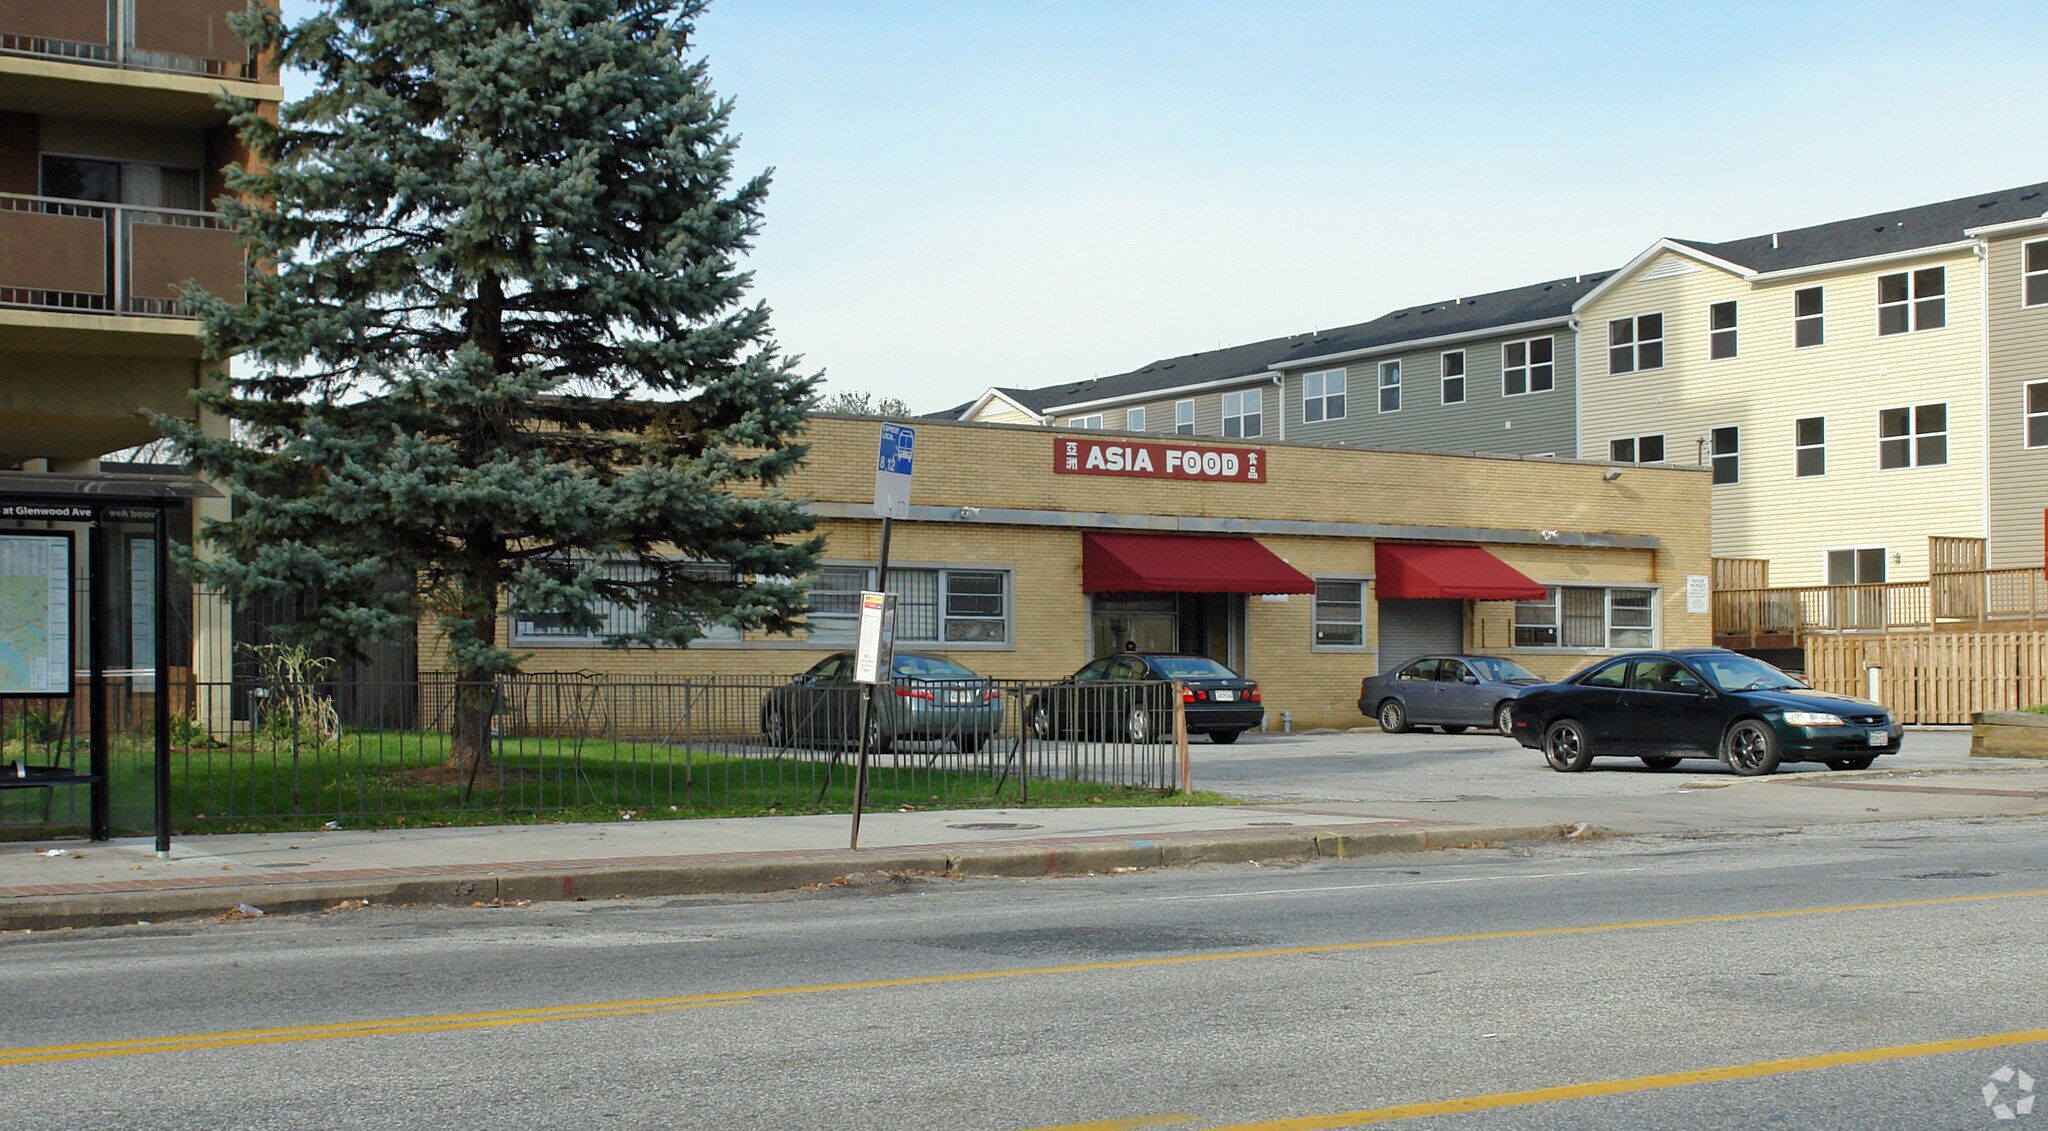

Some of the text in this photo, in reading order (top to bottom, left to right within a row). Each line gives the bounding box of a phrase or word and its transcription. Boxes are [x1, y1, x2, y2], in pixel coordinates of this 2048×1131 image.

[1066, 442, 1078, 471] 亞洲
[1085, 445, 1239, 476] ASIA FOOD
[1247, 452, 1258, 479] 食品
[2, 506, 92, 517] at Glenwood Ave
